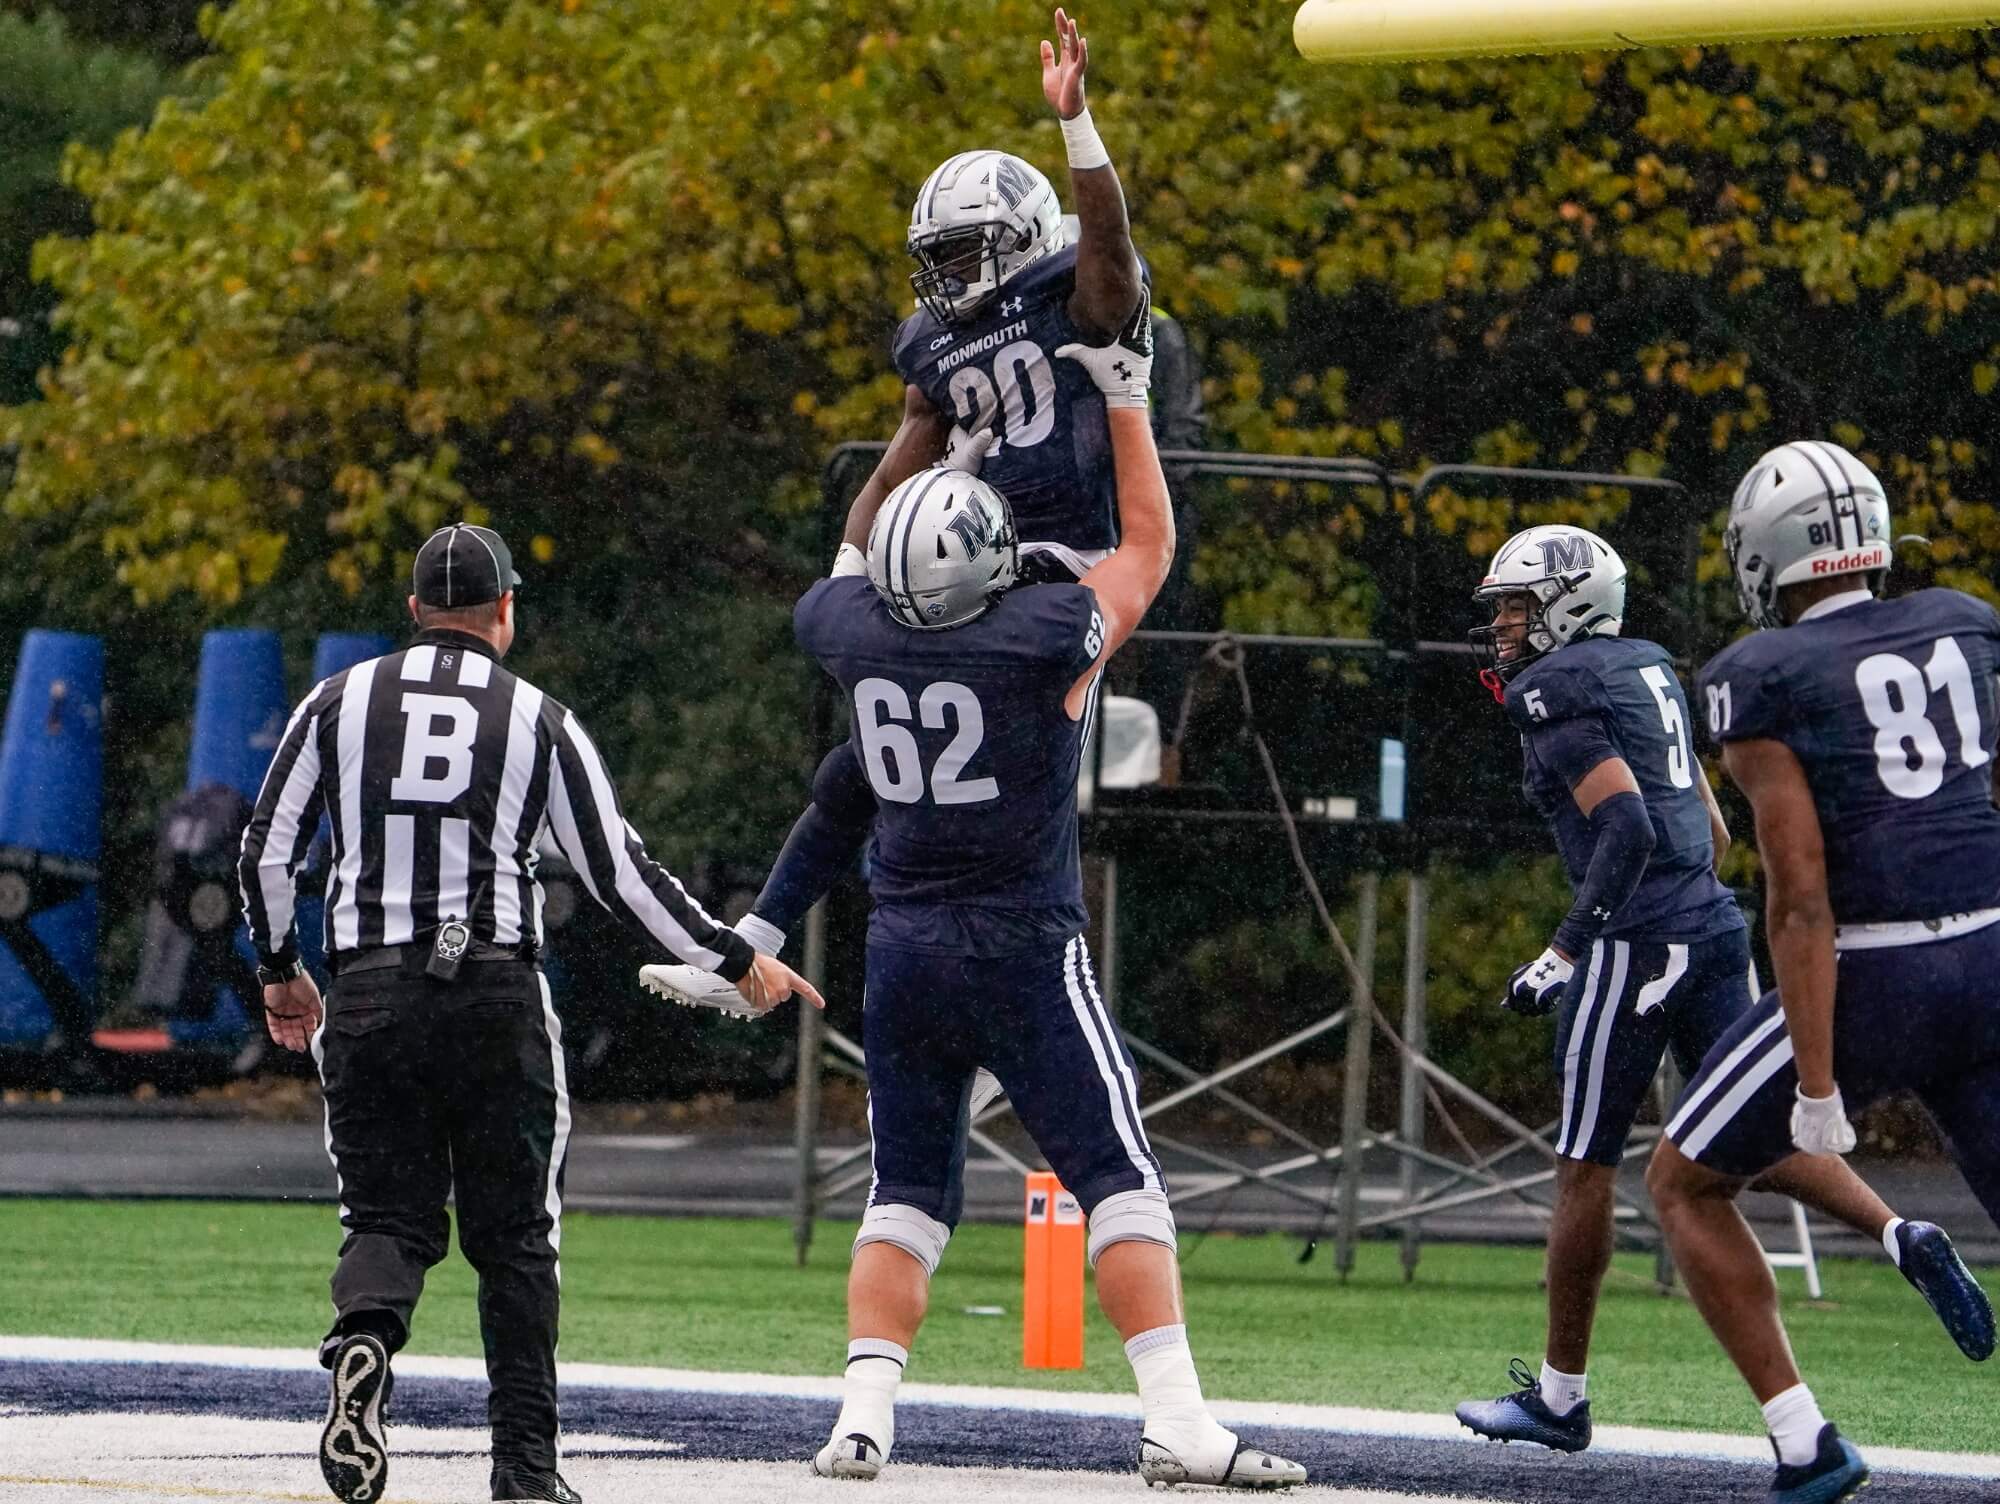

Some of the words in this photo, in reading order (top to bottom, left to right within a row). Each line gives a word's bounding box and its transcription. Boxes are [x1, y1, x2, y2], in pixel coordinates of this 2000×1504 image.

[996, 155, 1038, 211] M
[930, 332, 954, 351] CAA
[937, 319, 1028, 374] MONMOUTH
[946, 489, 1000, 562] M
[1808, 520, 1832, 545] 81
[1536, 535, 1595, 577] M
[1812, 549, 1882, 574] Riddell
[1084, 610, 1105, 659] 62
[1523, 689, 1549, 723] 5
[1640, 665, 1692, 789] 5
[1705, 680, 1732, 733] 81
[1855, 635, 1990, 799] 81
[391, 692, 480, 803] B
[854, 677, 1000, 805] 62
